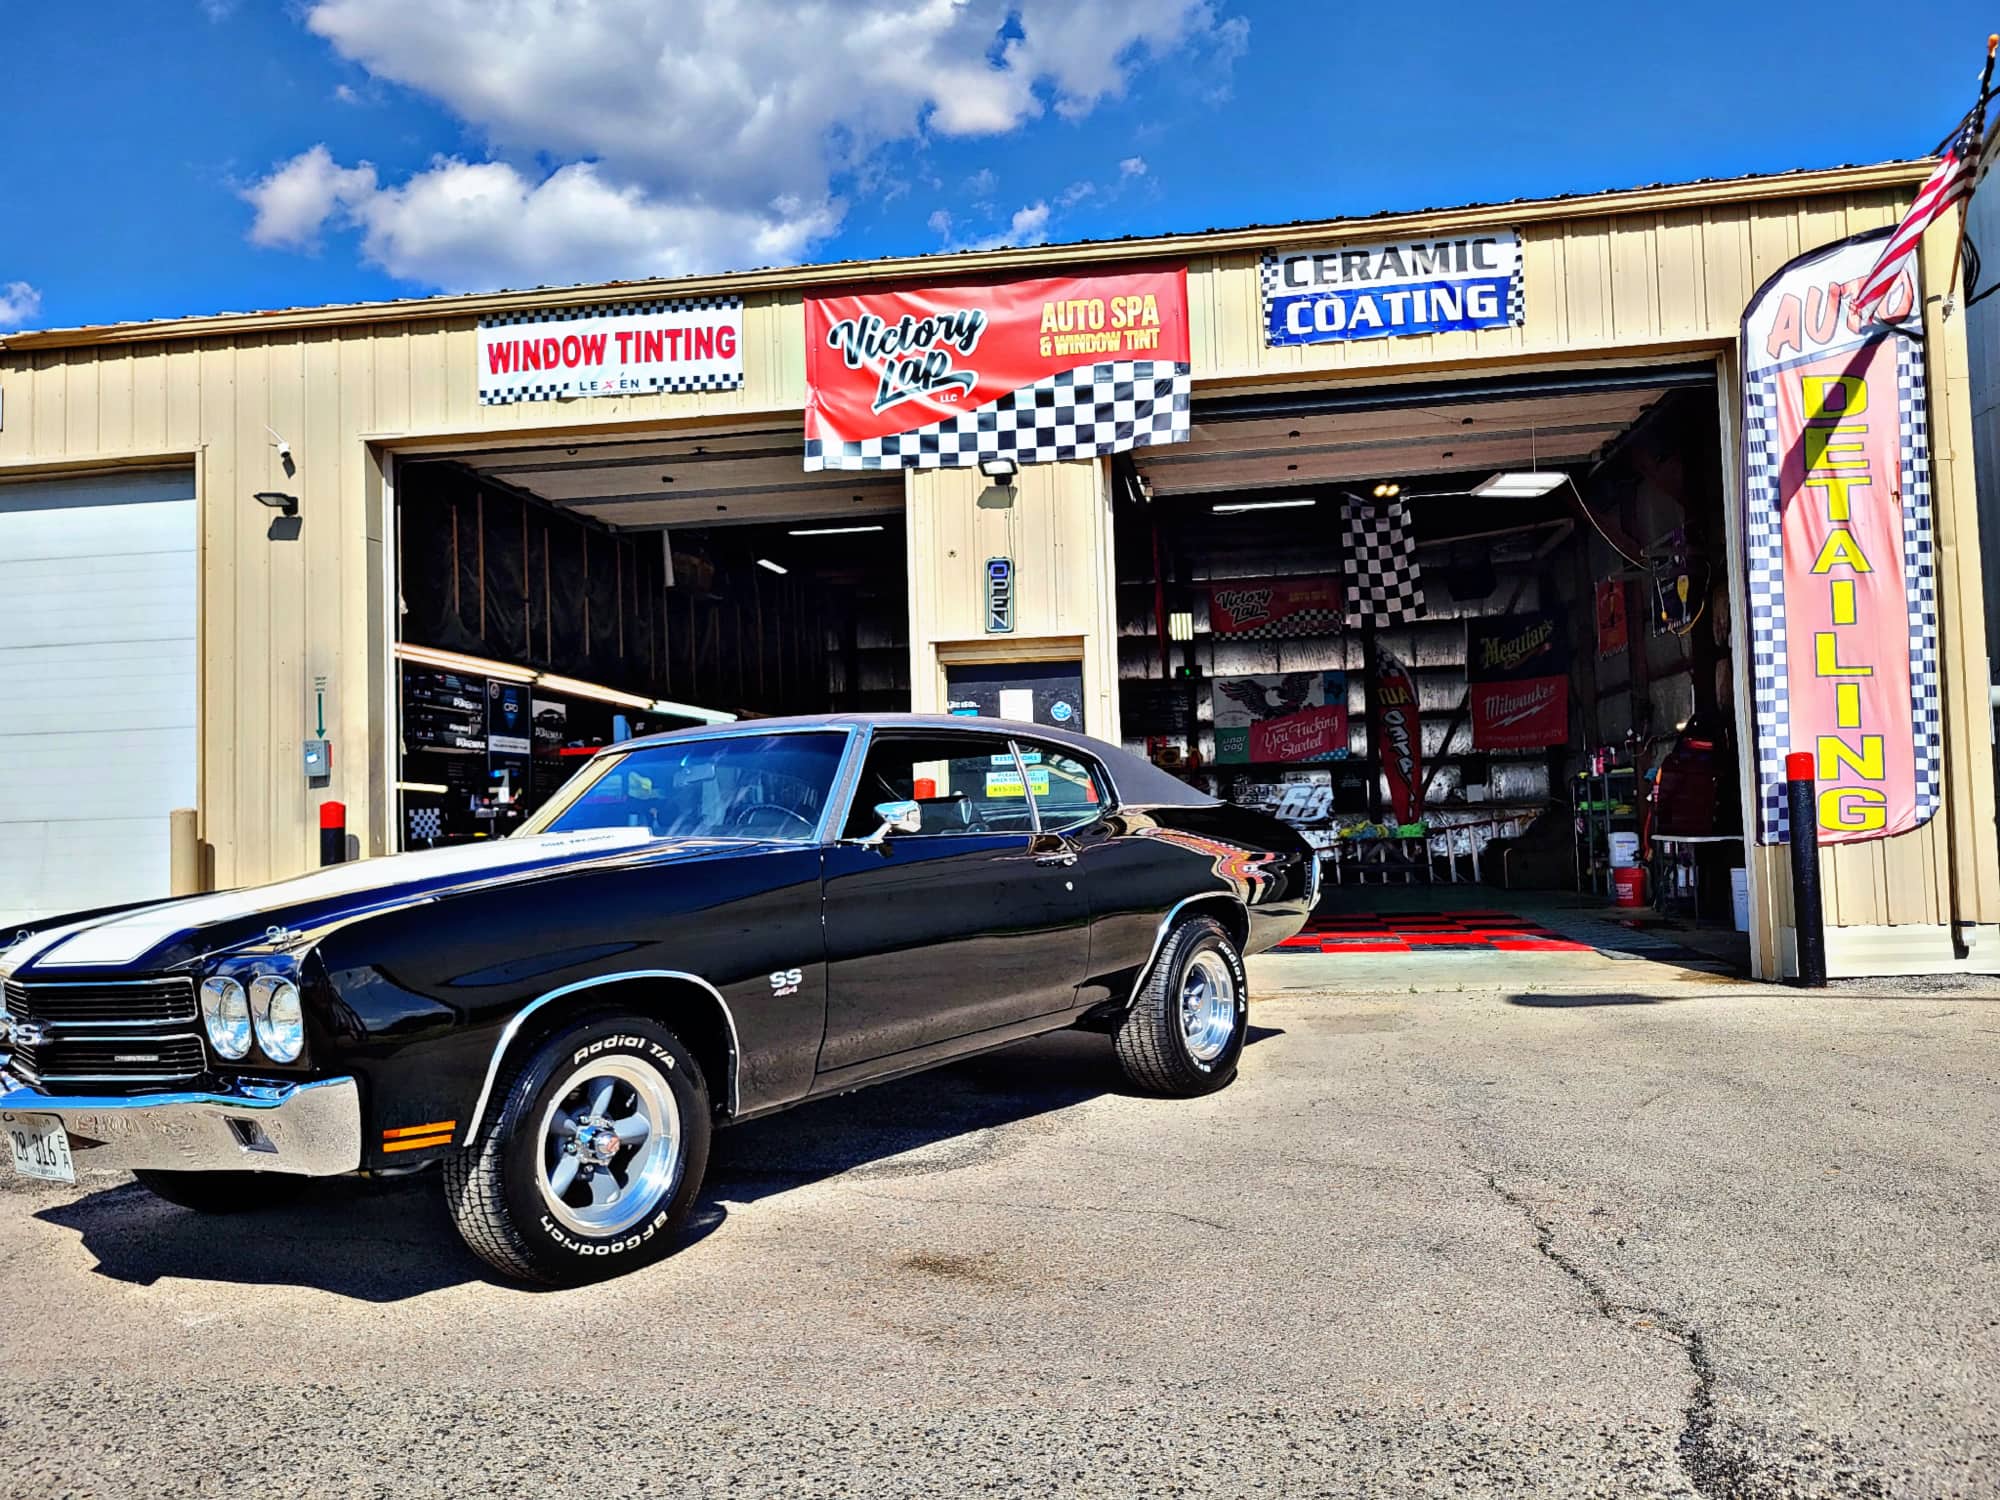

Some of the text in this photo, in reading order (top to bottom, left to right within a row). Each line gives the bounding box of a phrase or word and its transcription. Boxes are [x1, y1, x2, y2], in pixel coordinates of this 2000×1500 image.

[1283, 237, 1498, 288] CERAMIC
[1040, 294, 1160, 333] AUTO SPA
[1286, 284, 1499, 335] COATING
[487, 325, 736, 375] WINDOW TINTING
[827, 309, 986, 367] Victory
[1040, 328, 1160, 357] & WINDOW TINT
[872, 350, 962, 413] Lap
[940, 394, 957, 402] LLC
[990, 563, 1009, 628] OPEN
[1215, 589, 1273, 611] Victory
[1231, 604, 1270, 624] Lap
[1801, 374, 1887, 832] DETAILING
[769, 968, 802, 988] SS
[573, 1034, 677, 1070] Radial T/A
